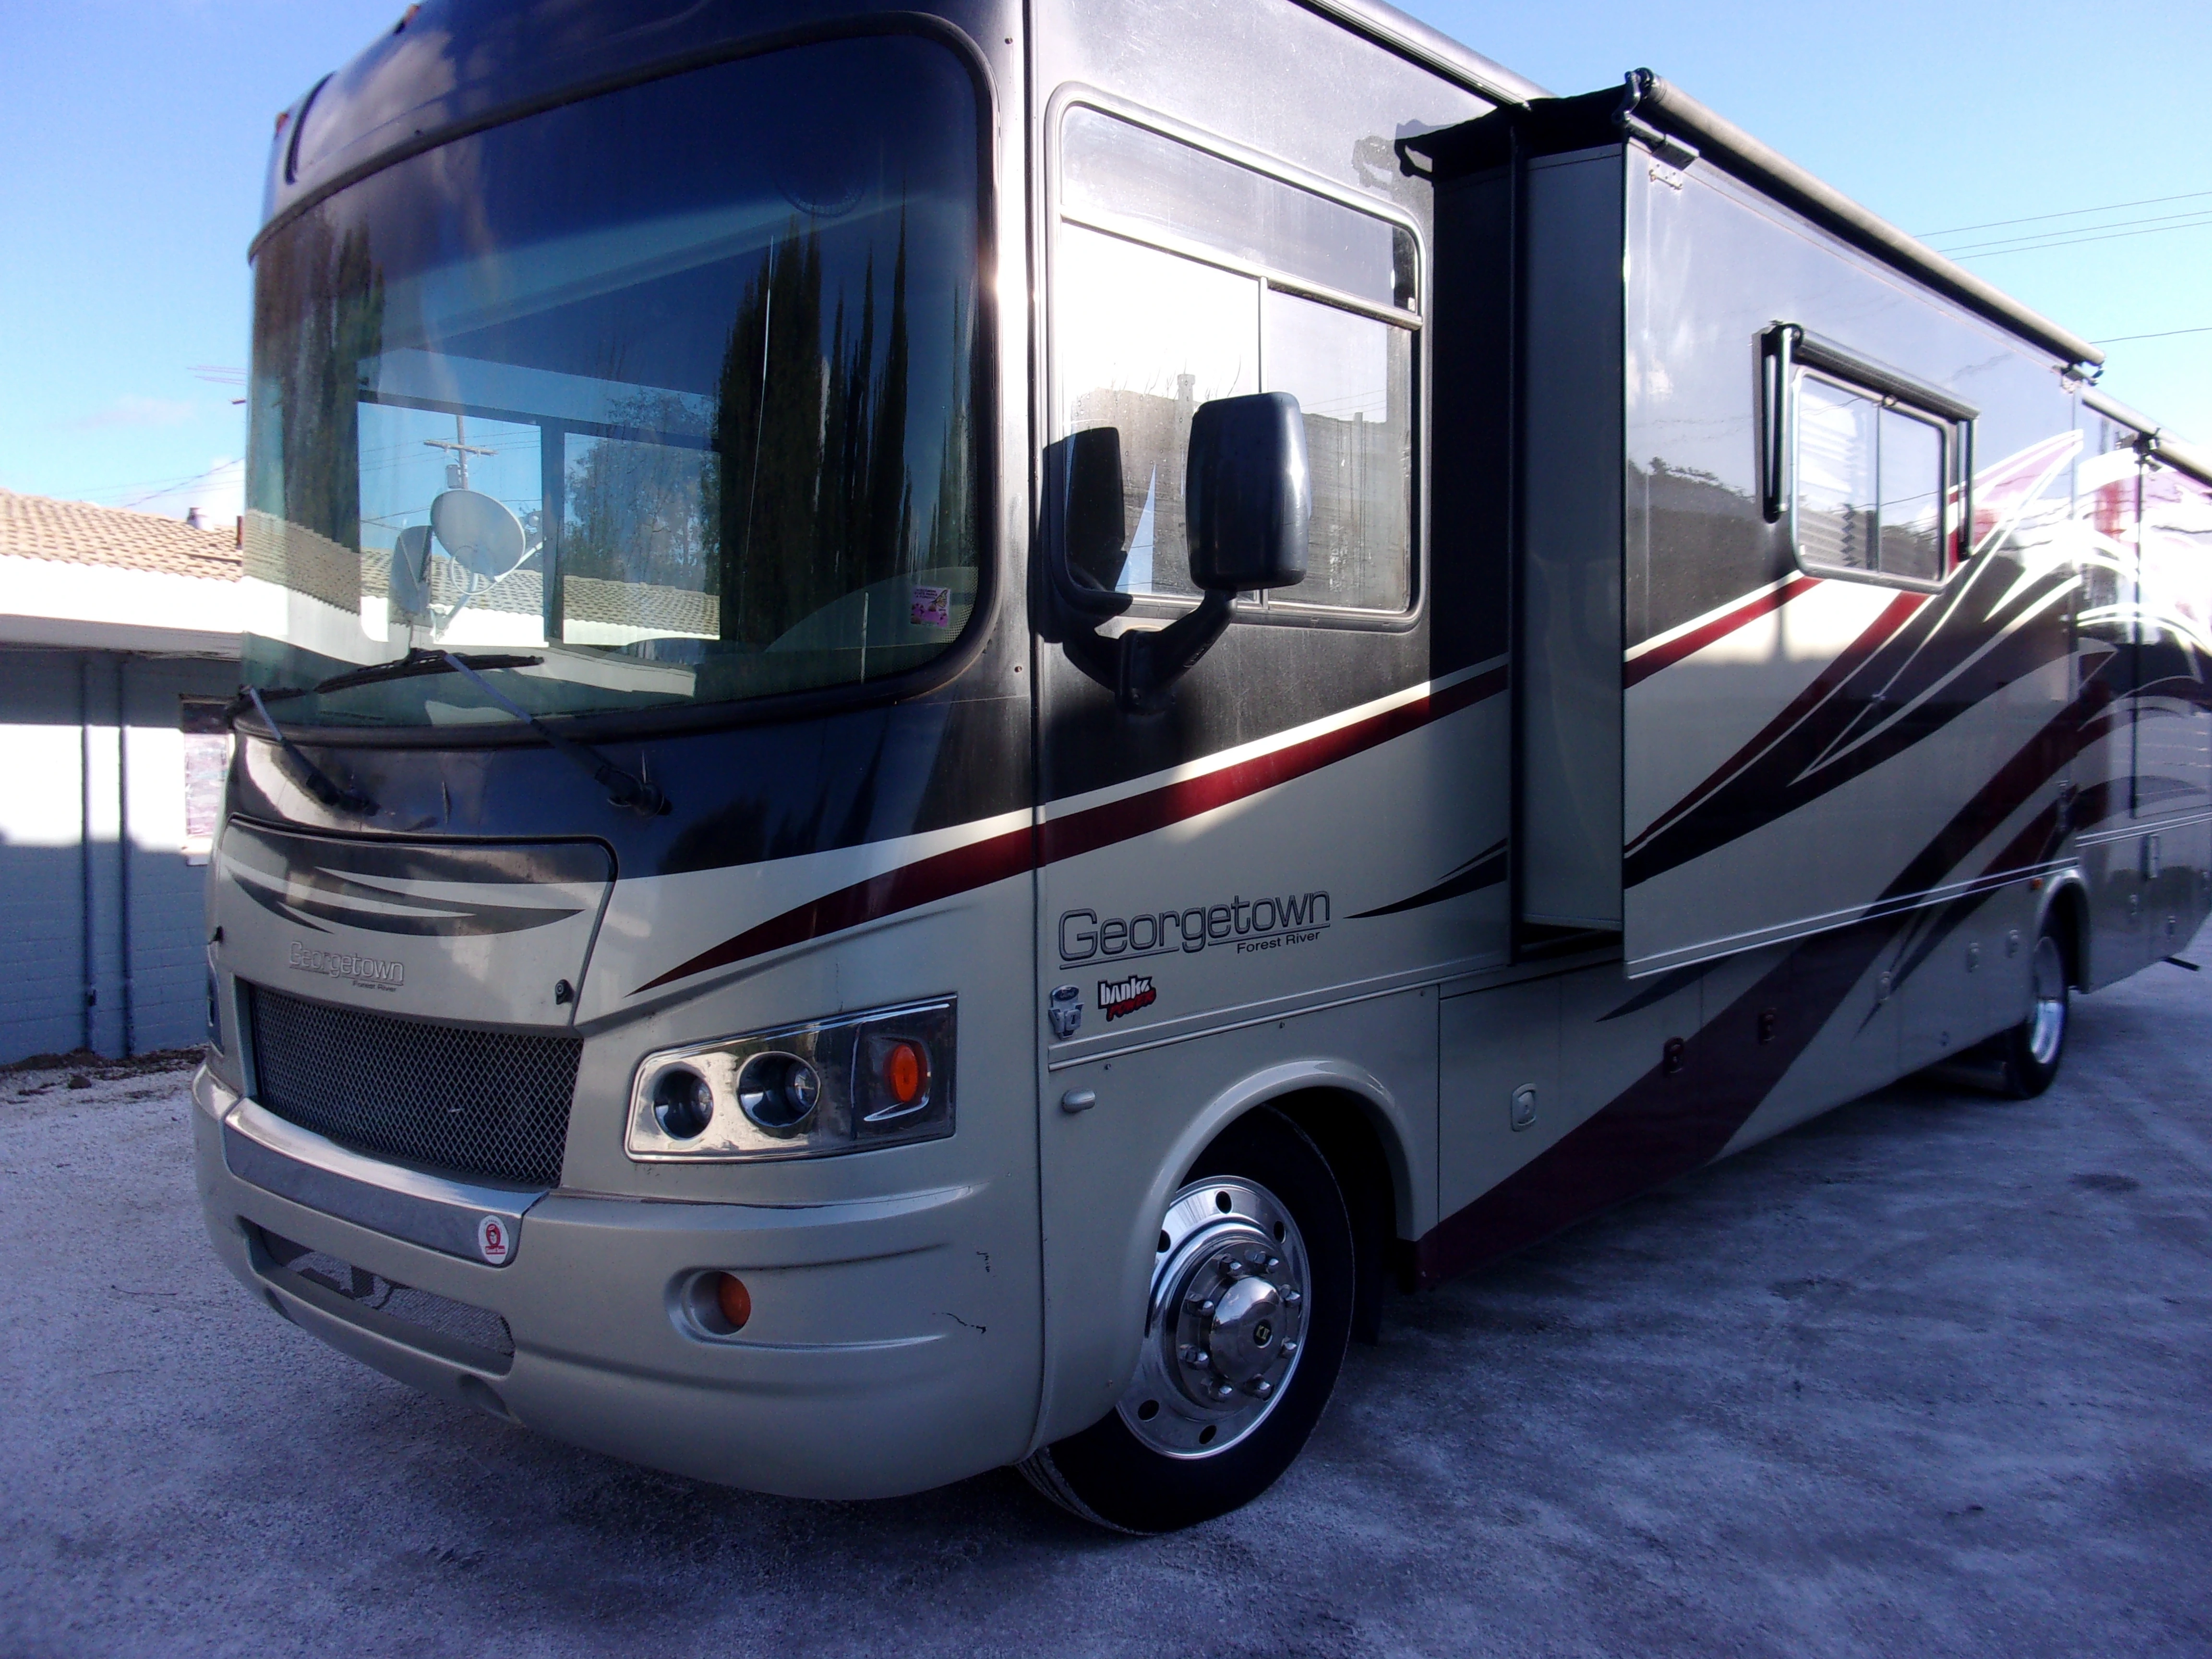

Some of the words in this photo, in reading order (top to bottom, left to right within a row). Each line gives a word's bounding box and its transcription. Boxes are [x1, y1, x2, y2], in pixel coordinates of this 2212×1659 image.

[1058, 890, 1330, 962] Georgetown
[1237, 937, 1281, 954] Forest
[1286, 932, 1320, 945] River
[289, 940, 404, 983] Georgetown
